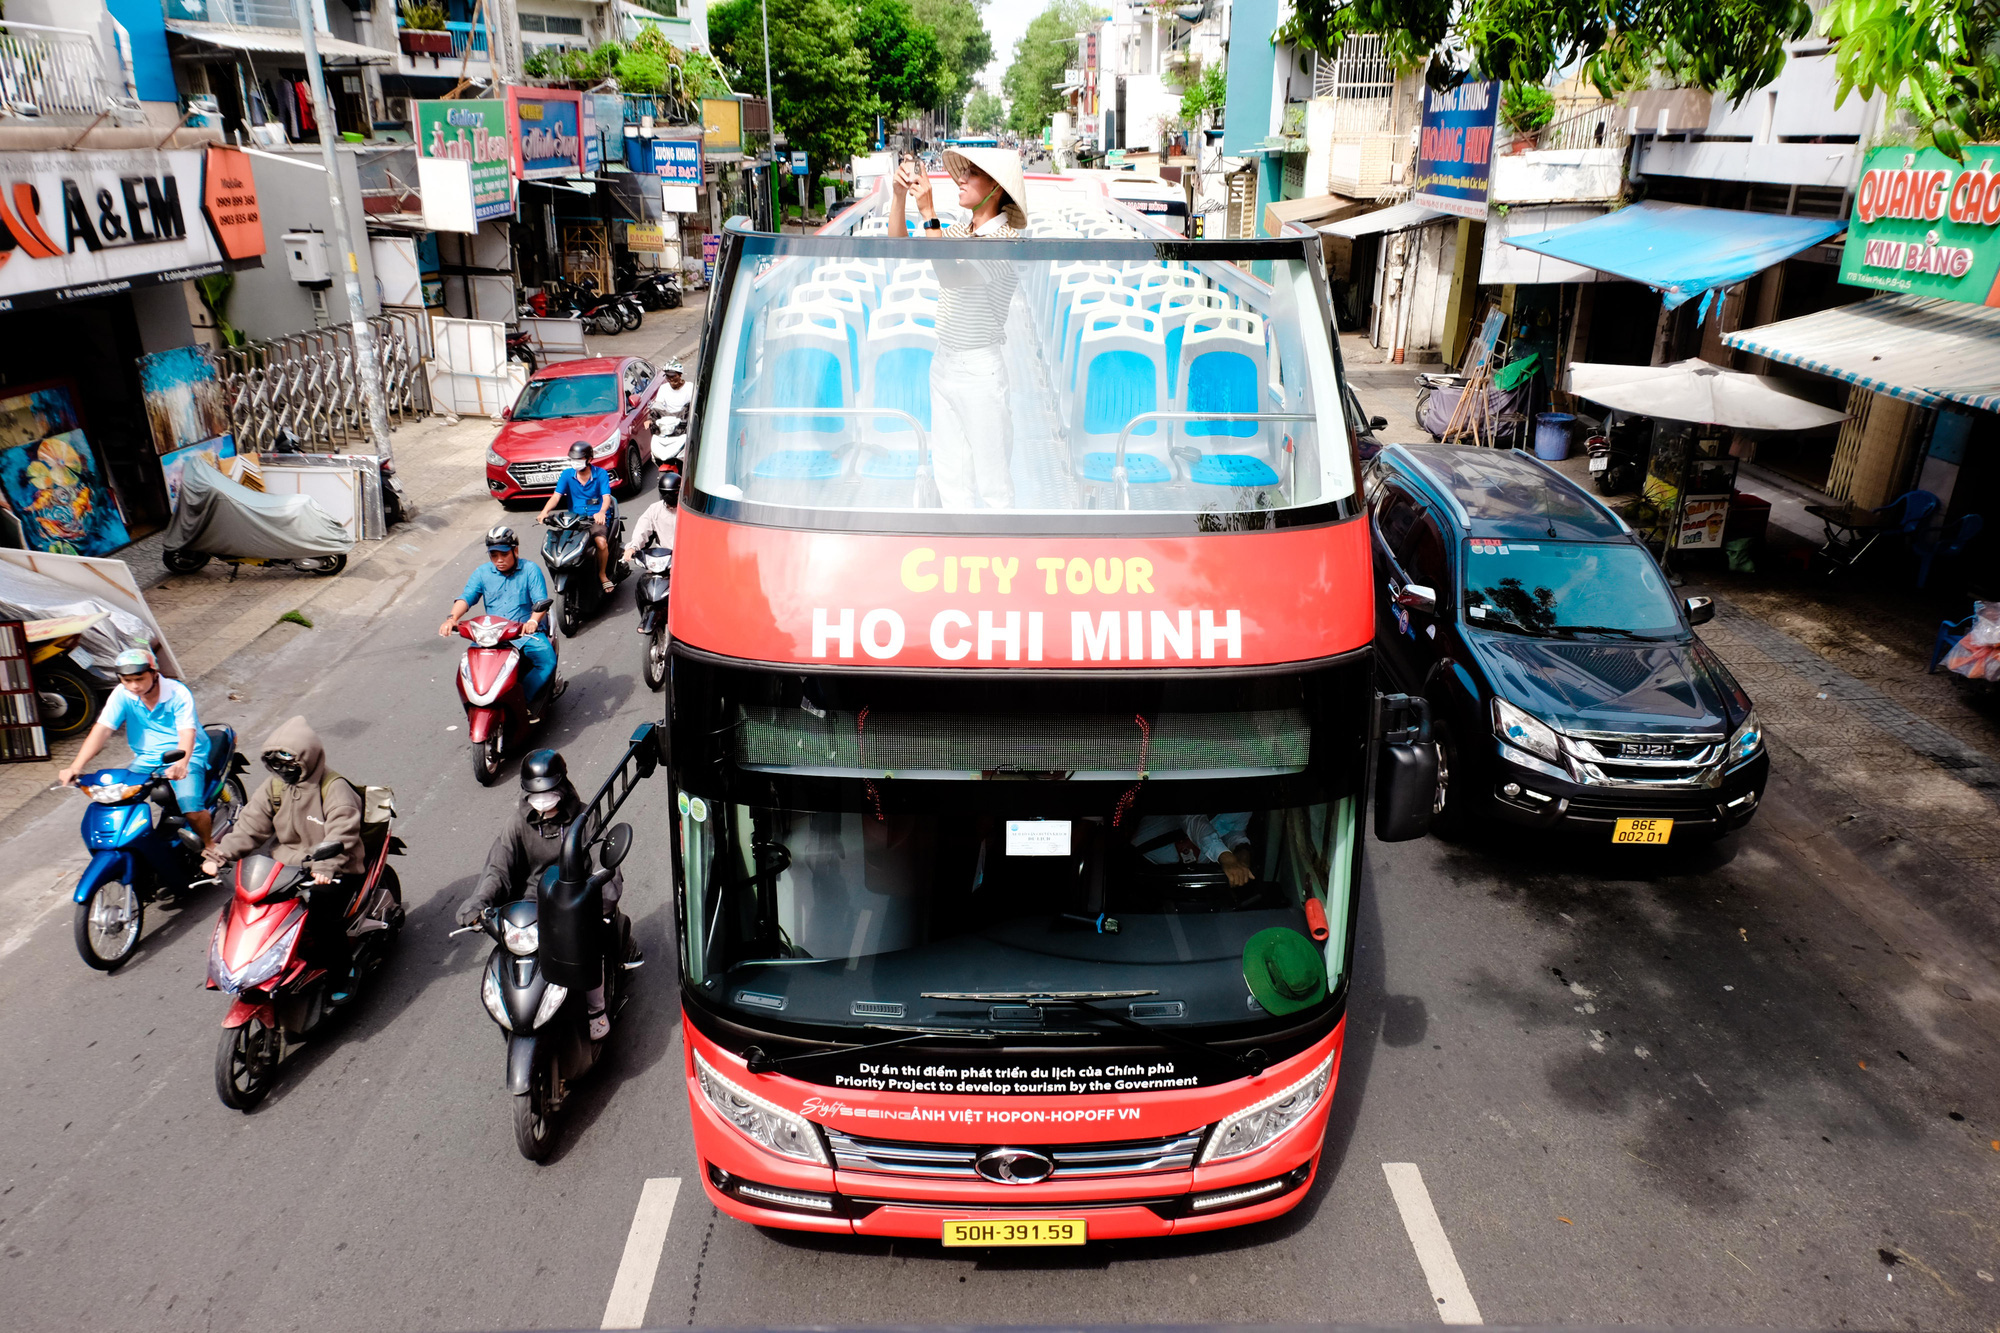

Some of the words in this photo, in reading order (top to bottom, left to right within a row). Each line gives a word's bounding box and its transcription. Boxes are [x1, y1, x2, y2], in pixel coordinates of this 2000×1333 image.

[1458, 81, 1490, 111] KHUNG
[447, 108, 484, 127] Gallery
[471, 127, 508, 163] Hoa
[675, 146, 696, 162] KHUNG
[1463, 126, 1493, 164] HUY
[1857, 153, 1953, 224] QUẢNG
[215, 197, 231, 208] 0909
[219, 215, 234, 226] 0903
[1863, 239, 1907, 270] KIM
[900, 547, 1018, 594] CITY
[1036, 555, 1154, 595] TOUR
[811, 608, 905, 660] HO
[930, 610, 1044, 661] CHI
[1071, 610, 1242, 661] MINH
[1620, 743, 1675, 755] ISUZU
[1631, 820, 1657, 831] 86E
[1618, 831, 1663, 843] 002.01
[860, 1063, 880, 1076] Dự
[882, 1064, 899, 1075] án
[901, 1065, 921, 1076] thí
[923, 1065, 957, 1078] điểm
[960, 1067, 992, 1080] phát
[995, 1066, 1027, 1078] triển
[1030, 1067, 1049, 1078] du
[1051, 1067, 1075, 1080] lịch
[1078, 1065, 1102, 1077] của
[1105, 1064, 1145, 1076] Chính
[1147, 1062, 1174, 1076] phủ
[835, 1075, 885, 1090] Priority
[888, 1078, 936, 1092] Project
[939, 1080, 953, 1091] to
[956, 1081, 1011, 1094] develop
[1014, 1081, 1066, 1093] tourism
[1069, 1081, 1087, 1094] by
[1089, 1080, 1111, 1091] the
[1114, 1075, 1198, 1090] Government
[911, 1106, 945, 1121] ẢNH
[948, 1108, 983, 1125] VIỆT
[986, 1109, 1115, 1123] HOPON-HOPOFF
[1118, 1108, 1141, 1120] VN
[955, 1225, 1074, 1241] 50H-391.59
